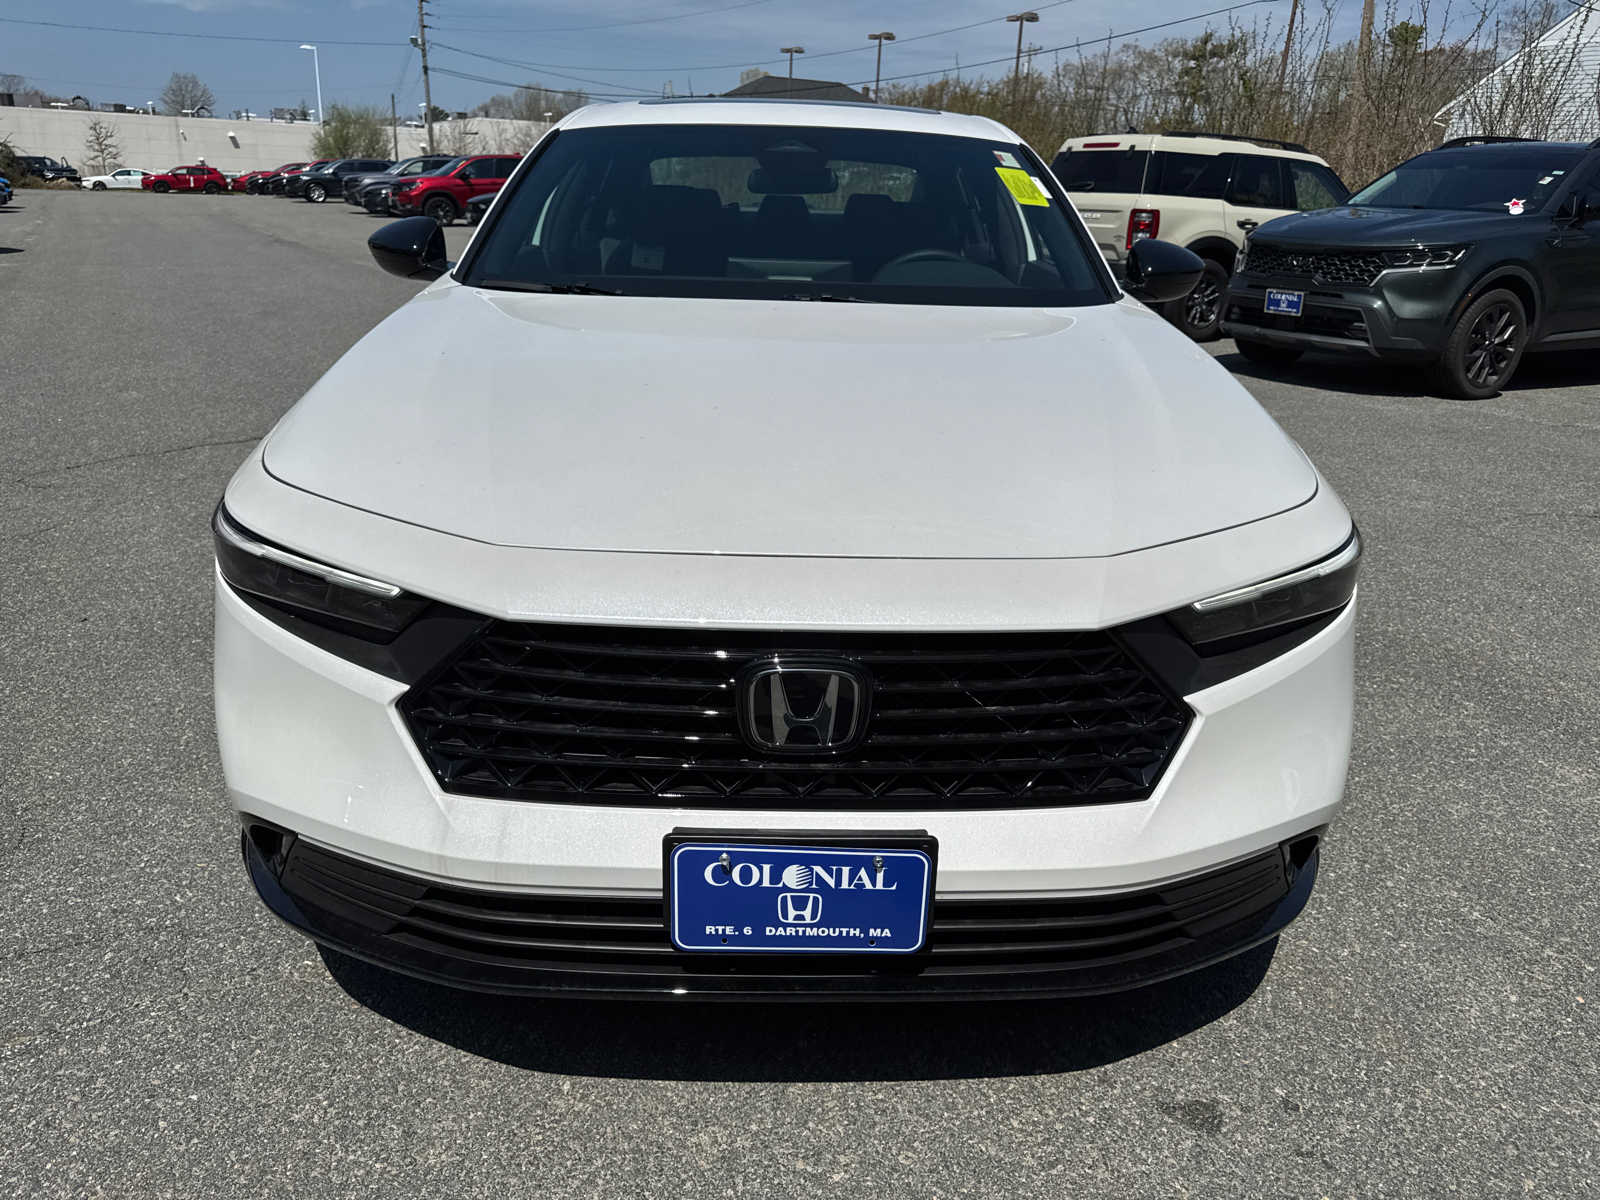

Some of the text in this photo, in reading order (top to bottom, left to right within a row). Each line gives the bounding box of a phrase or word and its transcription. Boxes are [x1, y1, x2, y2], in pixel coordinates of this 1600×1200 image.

[704, 862, 897, 890] COLONIAL
[705, 926, 892, 938] RTE. 6 DARTMOUTH, MA
